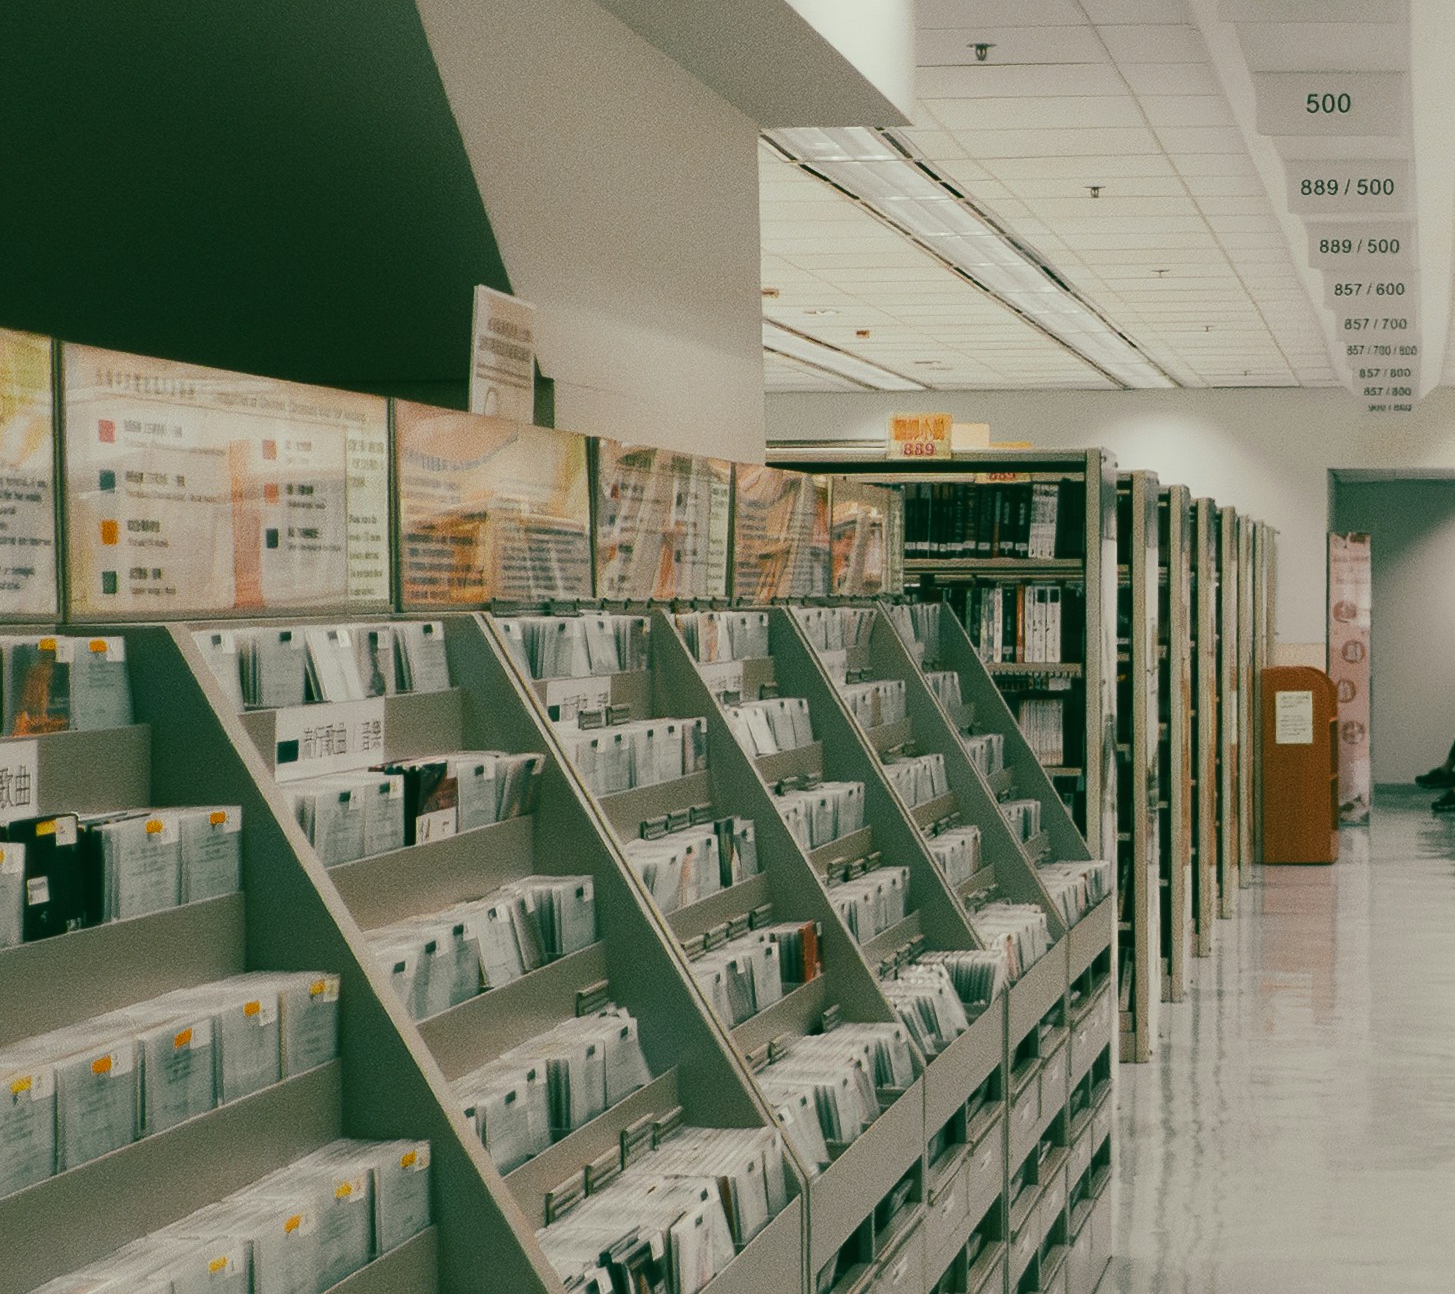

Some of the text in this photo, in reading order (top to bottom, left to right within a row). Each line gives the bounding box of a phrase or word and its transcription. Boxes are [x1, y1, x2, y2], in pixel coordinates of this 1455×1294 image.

[1307, 94, 1350, 113] 500
[1301, 179, 1394, 195] 889 / 500
[1320, 239, 1399, 253] 889 / 500
[1335, 284, 1362, 295] 857
[1377, 283, 1404, 295] 600
[1345, 319, 1369, 329] 857
[1383, 319, 1407, 329] 700
